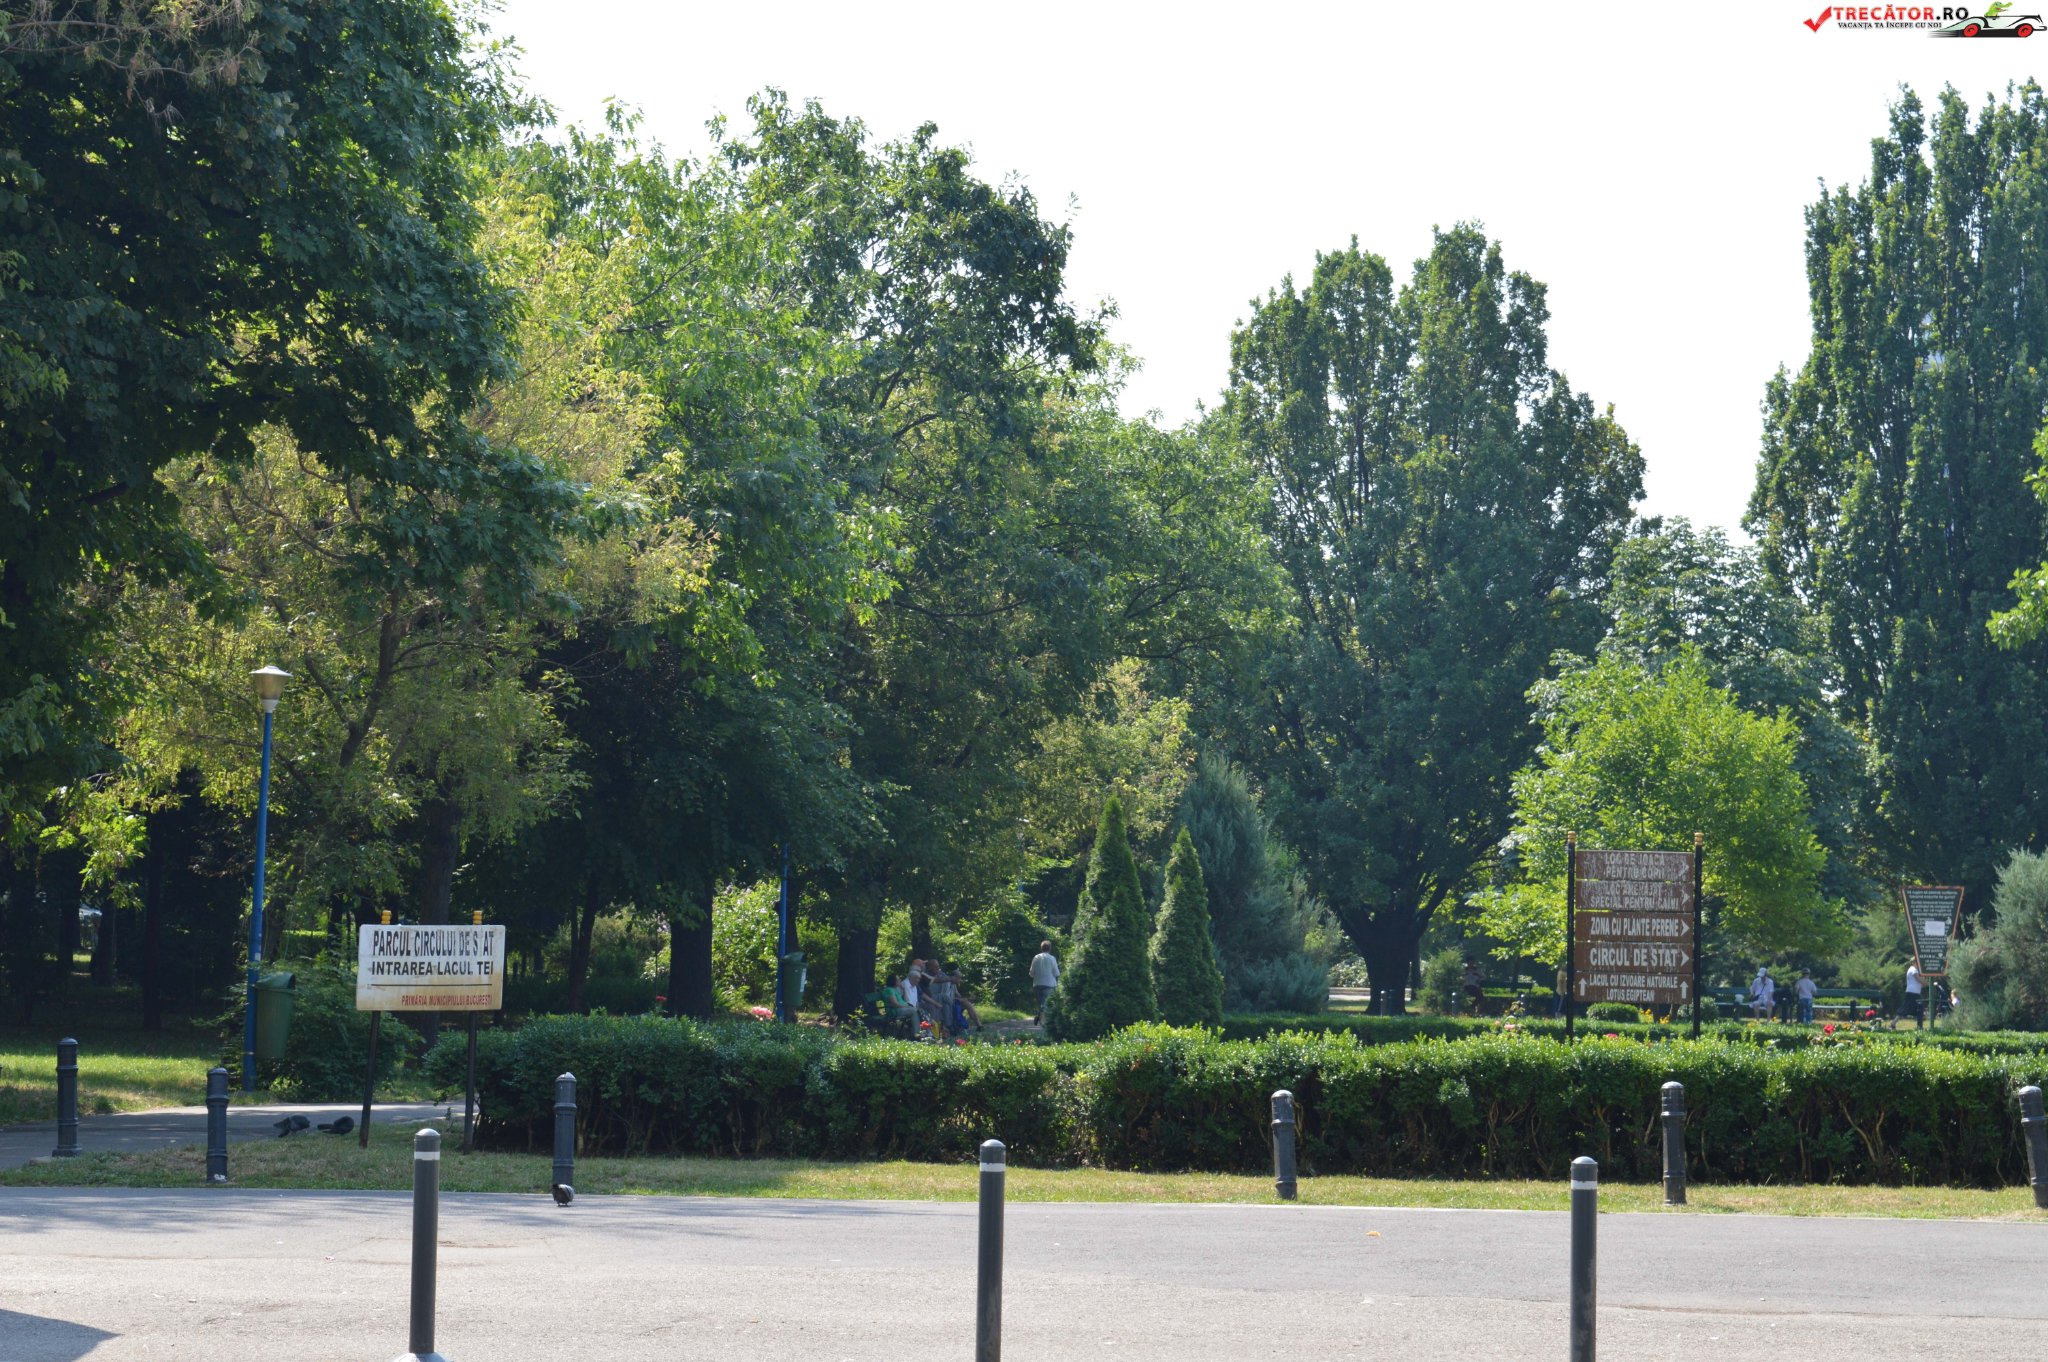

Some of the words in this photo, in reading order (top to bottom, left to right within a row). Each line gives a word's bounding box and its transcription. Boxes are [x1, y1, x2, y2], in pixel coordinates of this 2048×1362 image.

[1624, 853, 1635, 865] DE
[1625, 897, 1655, 908] PENTRU
[1590, 916, 1610, 935] ZONA
[1611, 917, 1622, 935] CU
[1623, 918, 1650, 936] PLANTE
[1651, 918, 1679, 937] PERENE
[373, 930, 411, 956] PARCUL
[414, 930, 456, 956] CIRCULUI
[459, 931, 471, 956] DE
[1590, 947, 1630, 966] CIRCUL
[1634, 948, 1648, 966] DE
[1651, 948, 1678, 967] STAT
[371, 961, 433, 975] INTRAREA
[437, 961, 472, 975] LACUL
[477, 961, 494, 975] TEI
[1589, 974, 1609, 986] LACUL
[1610, 975, 1619, 986] CU
[1620, 975, 1645, 987] IZVOARE
[1647, 976, 1678, 988] NATURALE
[1606, 988, 1625, 1000] LOTUS
[1626, 989, 1655, 1001] EGIPTEAN
